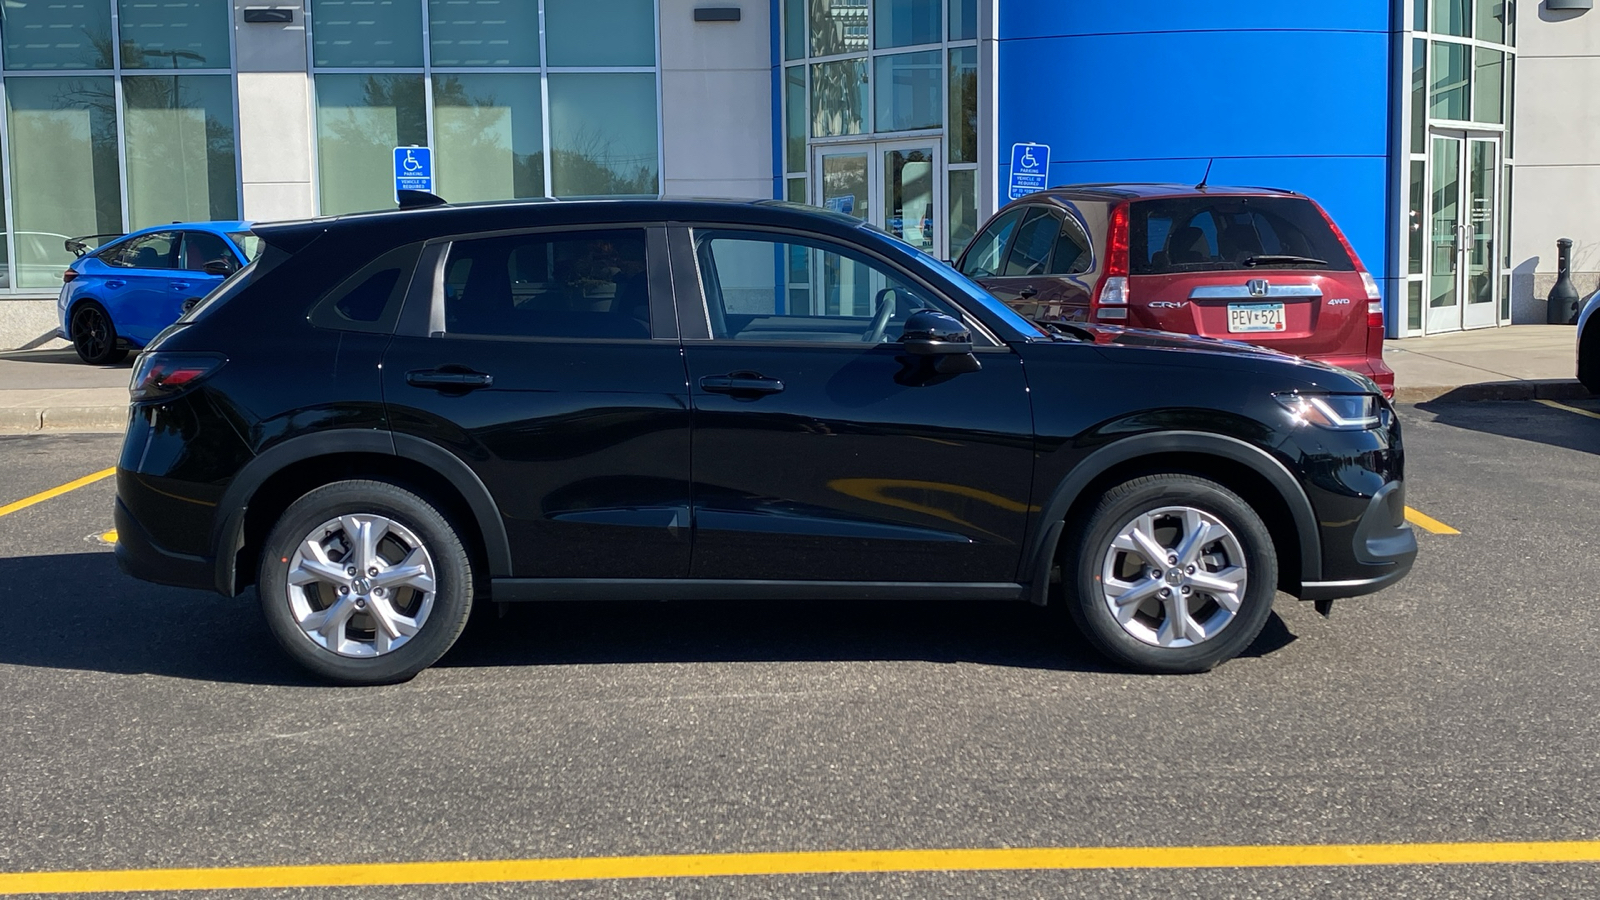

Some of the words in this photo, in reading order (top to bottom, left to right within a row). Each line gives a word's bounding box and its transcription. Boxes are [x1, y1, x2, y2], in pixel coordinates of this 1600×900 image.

[1148, 301, 1190, 309] CR-V
[1232, 310, 1252, 325] PEV
[1261, 310, 1282, 325] 521
